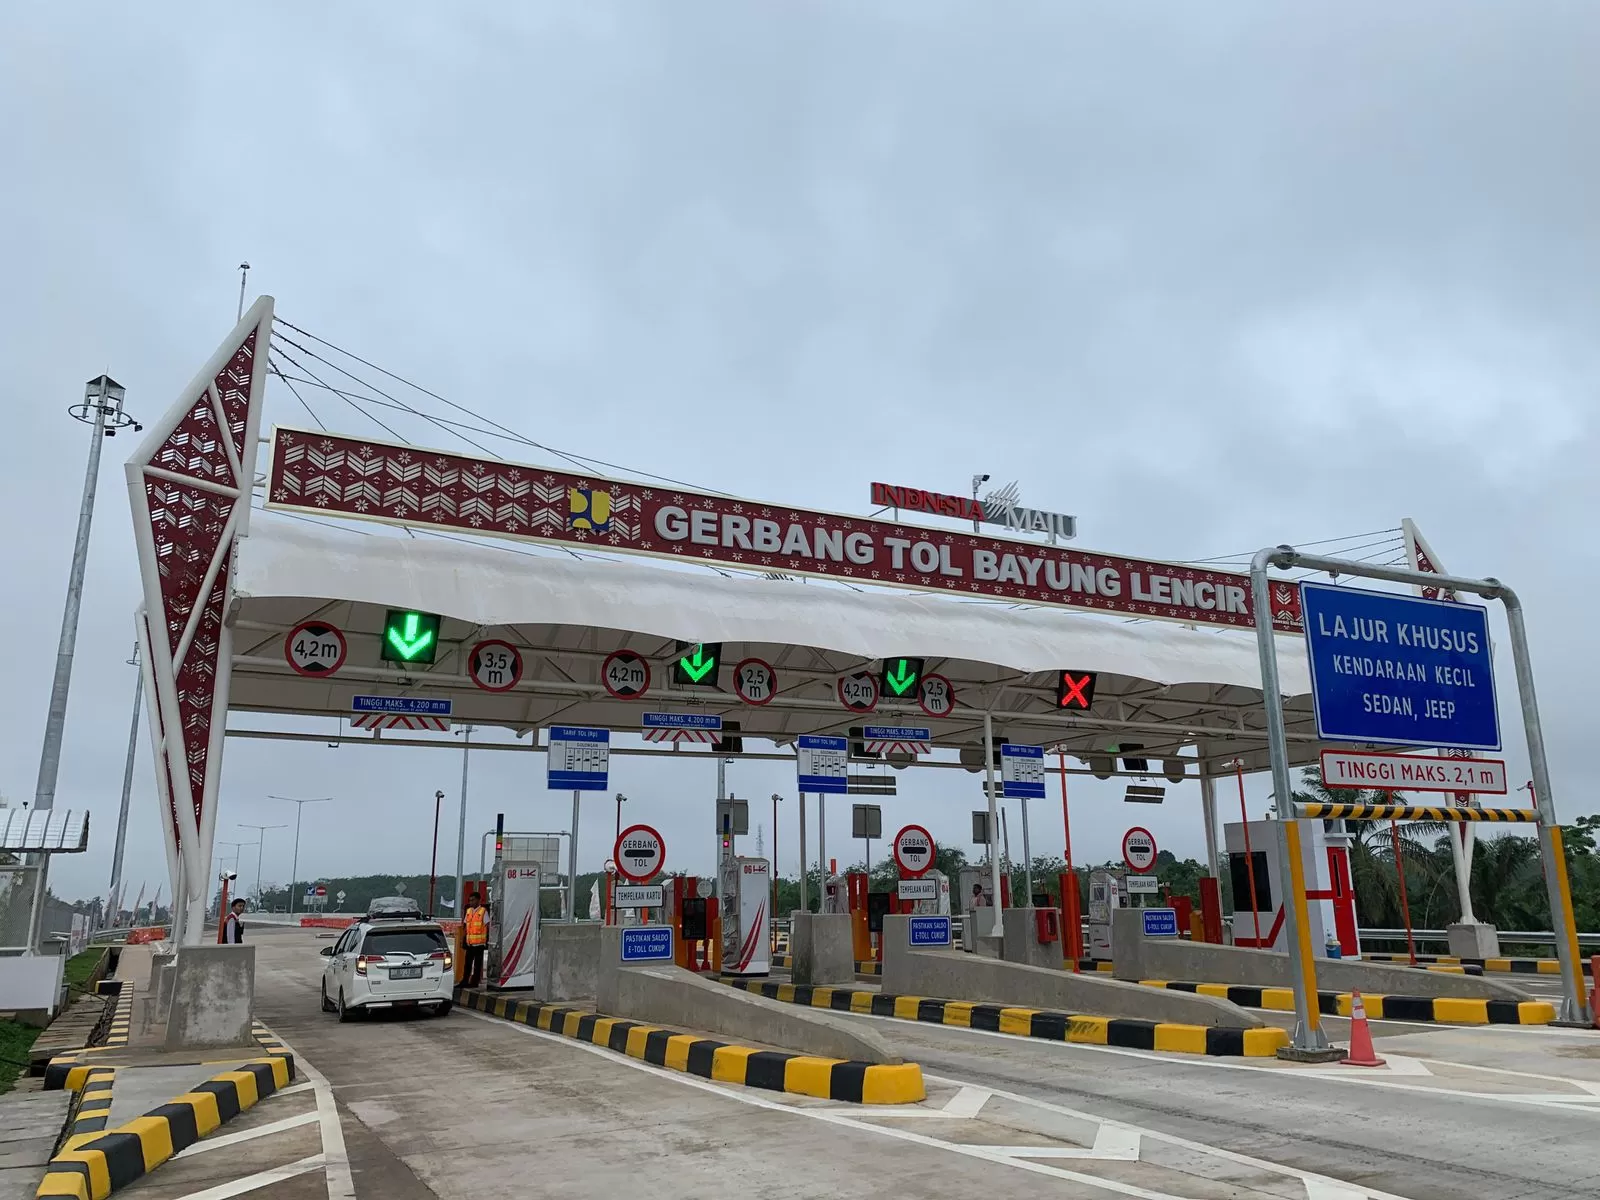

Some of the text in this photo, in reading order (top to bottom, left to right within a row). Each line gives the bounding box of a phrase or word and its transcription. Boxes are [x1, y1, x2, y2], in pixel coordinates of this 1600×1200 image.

[1004, 505, 1077, 544] MAJU
[654, 506, 1248, 615] GERBANG TOL BAYUNG LENCIR
[1318, 612, 1479, 654] LAJUR KHUSUS
[484, 653, 507, 670] 3,5
[1333, 654, 1475, 687] KENDARAAN KECIL
[488, 671, 503, 684] m
[746, 669, 764, 684] 2,5
[750, 686, 761, 698] m
[927, 681, 943, 697] 2,5
[359, 698, 383, 706] TINGGI
[385, 699, 406, 708] MAKS.
[931, 698, 942, 709] m
[1363, 693, 1456, 721] SEDAN, JEEP
[649, 714, 668, 722] TINGGI
[1336, 761, 1494, 786] TINGGI MAKS. 2,1 m
[622, 840, 658, 849] GERBANG
[900, 838, 929, 846] GERBANG
[1128, 838, 1151, 846] GERBANG
[633, 859, 648, 867] TOL
[910, 854, 921, 862] TOL
[900, 885, 934, 894] TEMPELKAN KARTU
[618, 891, 661, 901] TEMPELKAN KARTU
[625, 933, 669, 942] PASTIKAN SALDO
[915, 931, 945, 940] E-TOLL CUKUP
[628, 944, 665, 953] E-TOLL CUKUP
